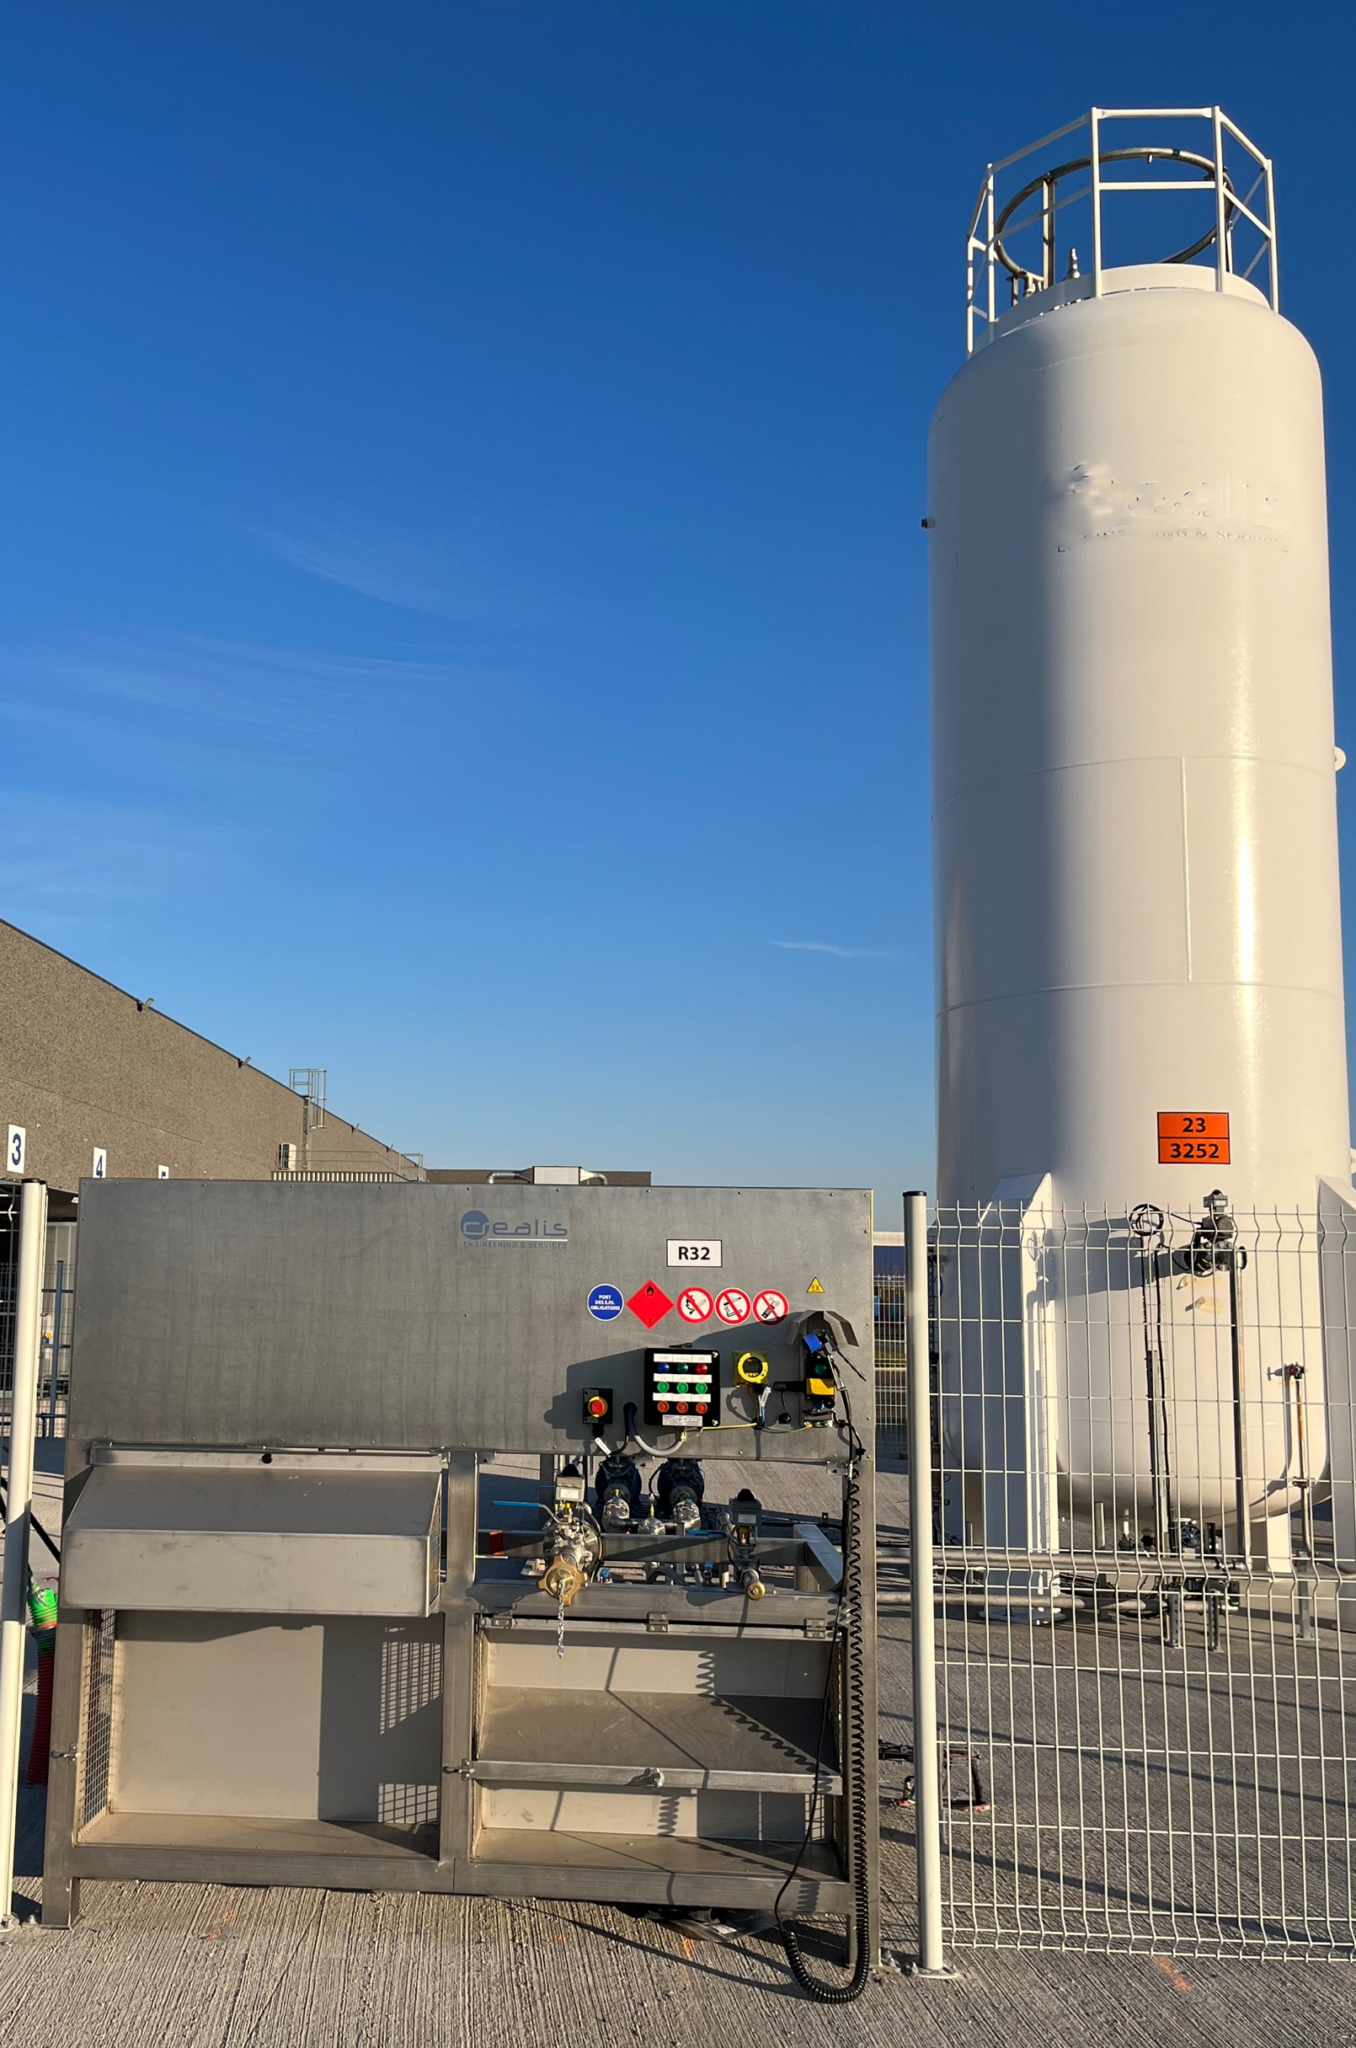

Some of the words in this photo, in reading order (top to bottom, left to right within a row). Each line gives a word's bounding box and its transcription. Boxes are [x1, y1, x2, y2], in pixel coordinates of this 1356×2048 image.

[1182, 1117, 1206, 1133] 23
[11, 1133, 22, 1166] 3
[1170, 1143, 1220, 1159] 3252
[528, 1241, 568, 1249] SERVICES
[678, 1246, 710, 1260] R32
